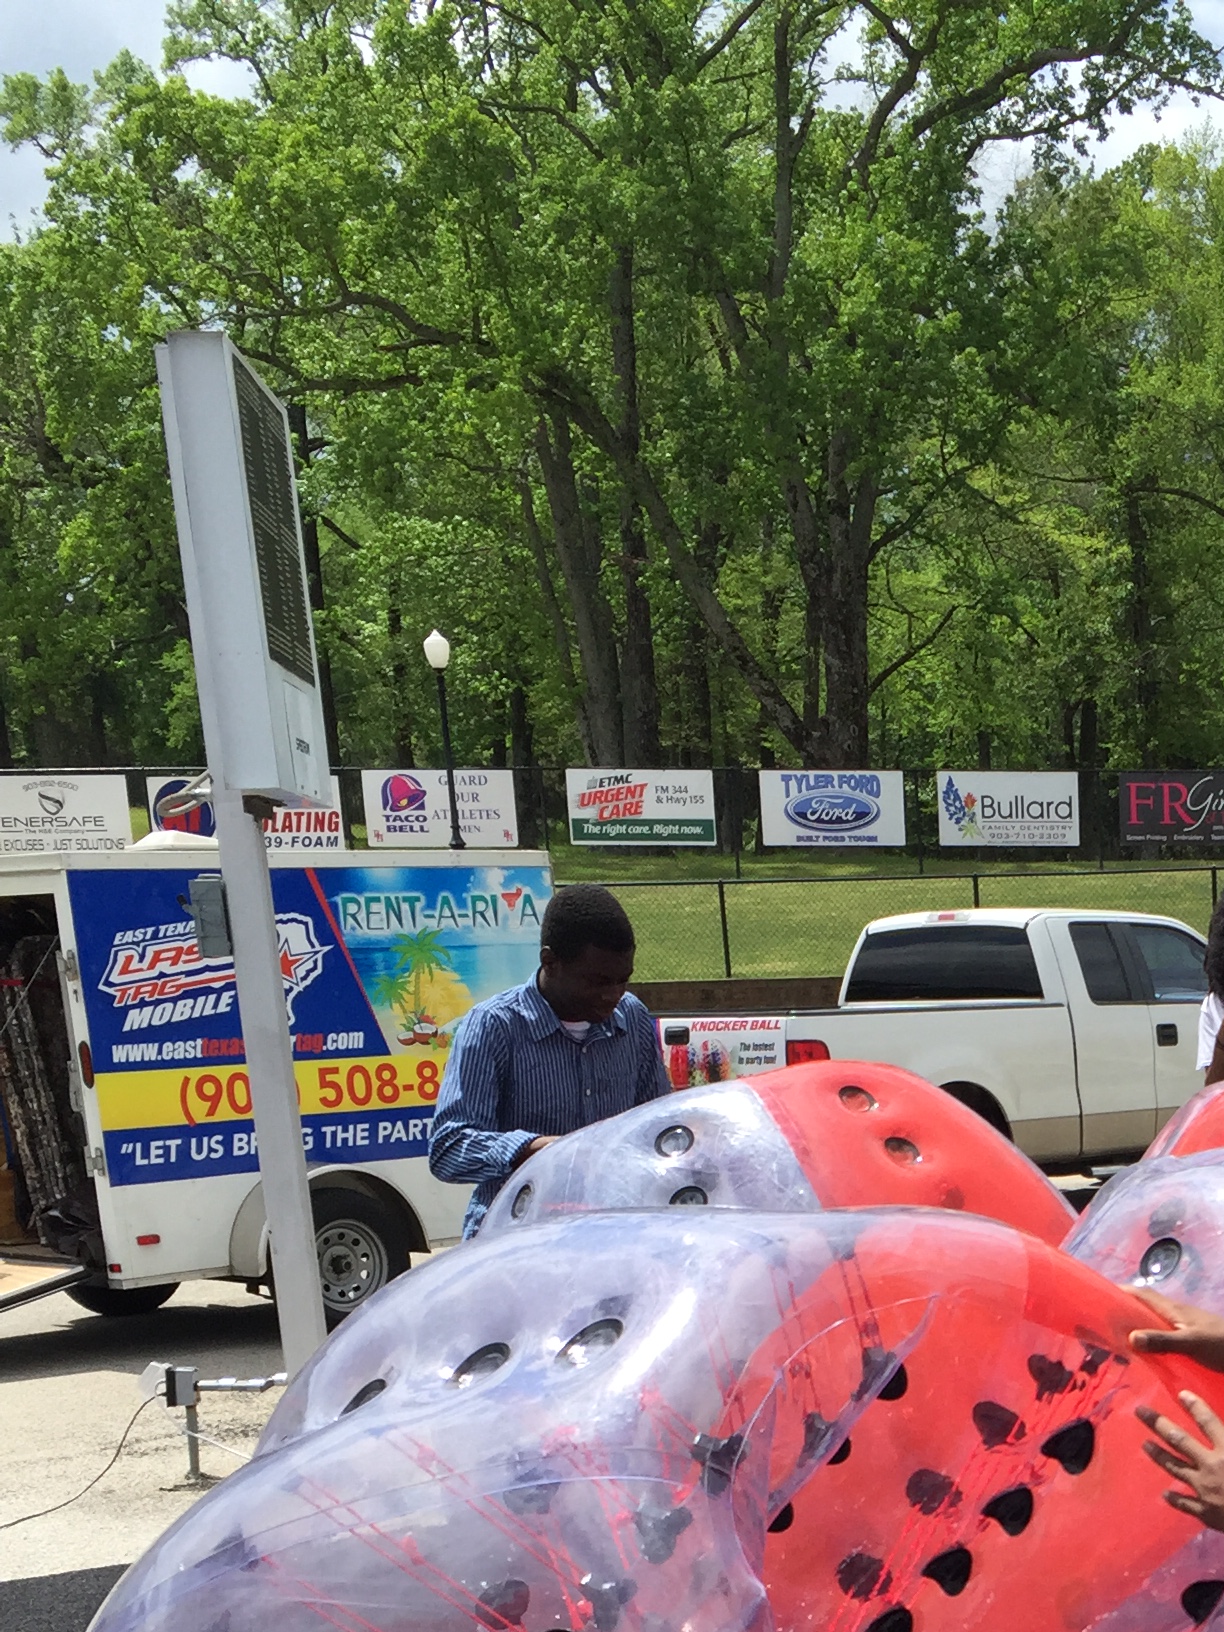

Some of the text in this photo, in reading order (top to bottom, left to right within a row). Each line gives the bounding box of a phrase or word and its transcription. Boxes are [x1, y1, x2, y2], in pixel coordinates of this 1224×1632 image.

[438, 775, 488, 786] GARD
[599, 773, 633, 788] ETMC
[654, 785, 689, 794] FM 344
[781, 774, 881, 798] TYLER FORD
[579, 783, 649, 808] URGENT
[655, 796, 663, 804] &
[666, 795, 687, 806] Hwy
[431, 809, 501, 820] ATLETES
[597, 800, 644, 822] CARE
[806, 797, 857, 821] Ford
[981, 795, 1073, 819] Bullard
[1, 815, 105, 828] ENERSAFE
[262, 811, 340, 833] LATING
[382, 814, 428, 823] TACO
[386, 825, 429, 833] BELL
[583, 823, 704, 837] The right care. Right now.
[4, 838, 126, 851] EXCUSES JUST SOLUTIONS
[265, 835, 339, 848] 39-FOAM
[113, 920, 196, 946] EAST TEXA
[117, 943, 204, 976] LAS
[113, 974, 187, 1005] TAG
[122, 990, 236, 1032] MOBILE
[691, 1020, 781, 1031] KNOCKER BALL
[318, 1060, 447, 1108] 508-8
[190, 1135, 224, 1160] US
[321, 1122, 369, 1148] THE
[377, 1117, 434, 1144] PART
